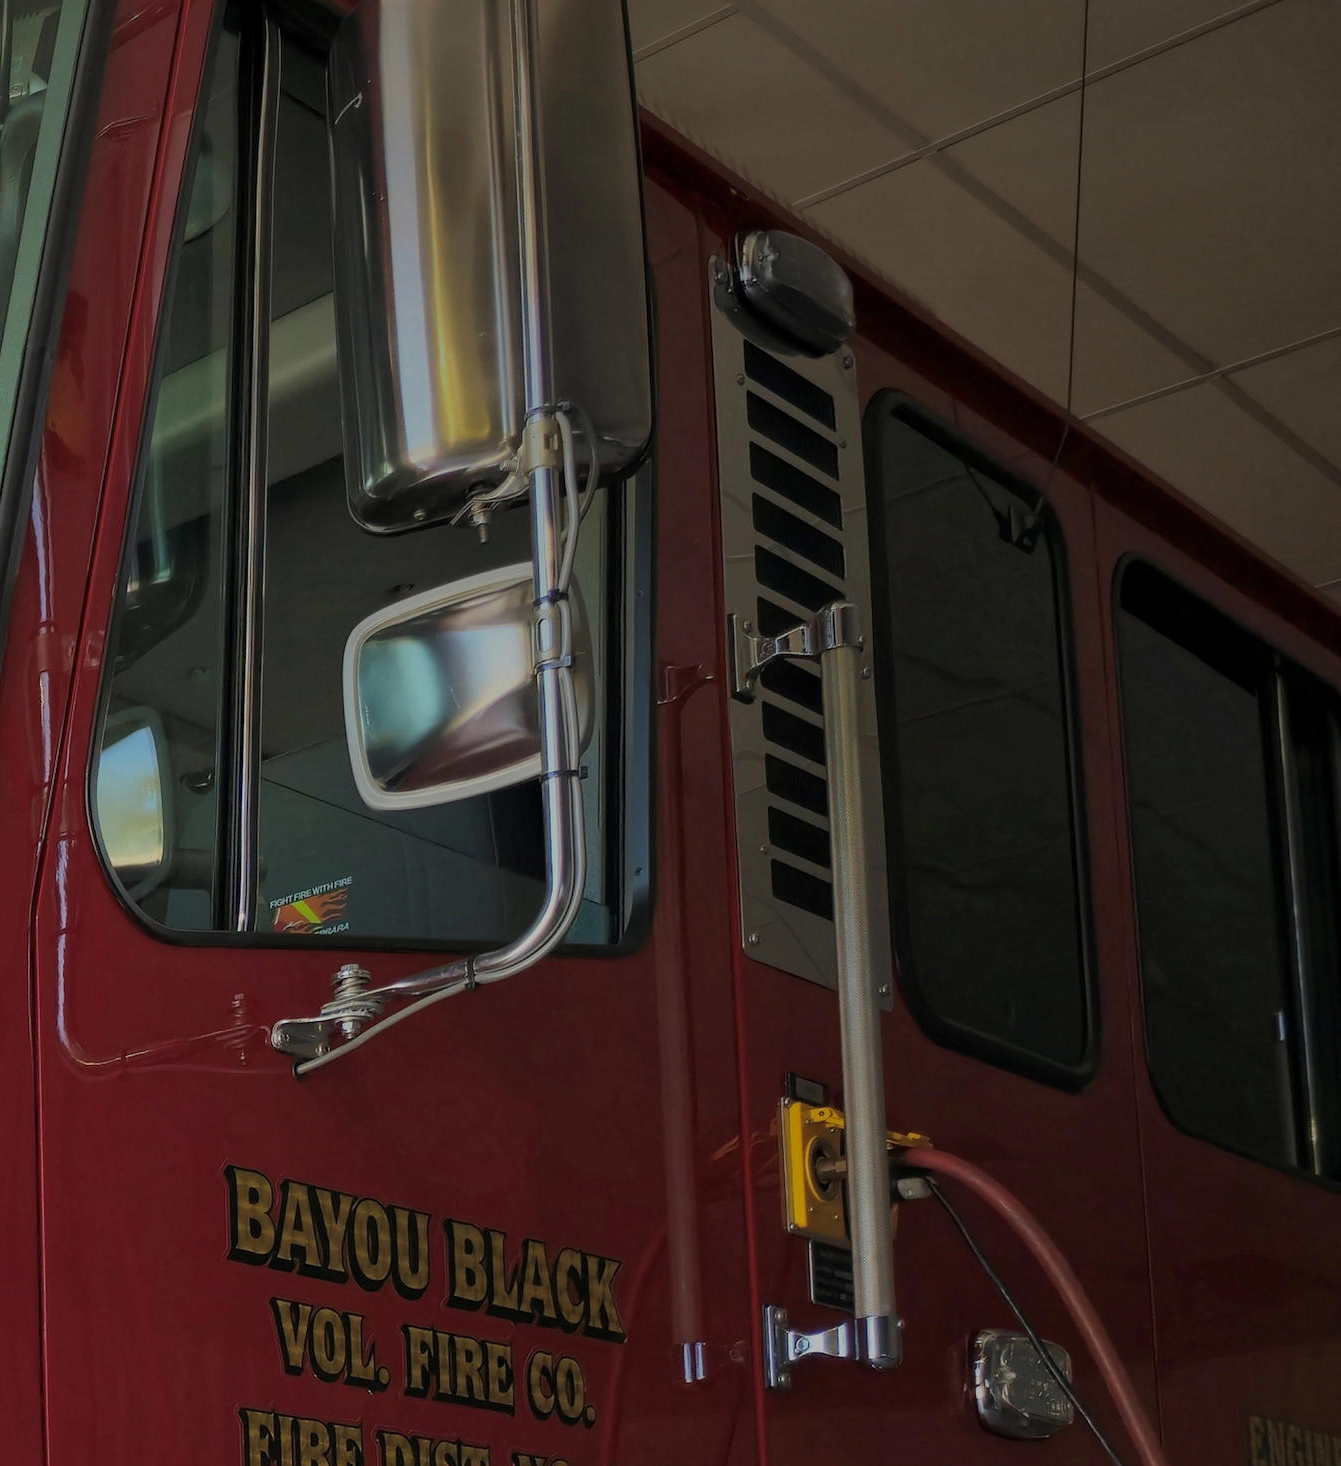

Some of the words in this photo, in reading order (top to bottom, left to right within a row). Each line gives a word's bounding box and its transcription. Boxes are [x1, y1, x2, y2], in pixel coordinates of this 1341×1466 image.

[269, 894, 294, 909] FIGHT
[293, 888, 312, 902] FIRE
[312, 881, 334, 896] WITH
[334, 875, 353, 889] FIRE
[224, 1165, 431, 1299] BAYOU
[444, 1218, 626, 1343] BLACK
[271, 1298, 391, 1387] VOL.
[402, 1324, 515, 1414] FIRE
[528, 1350, 597, 1426] CO.
